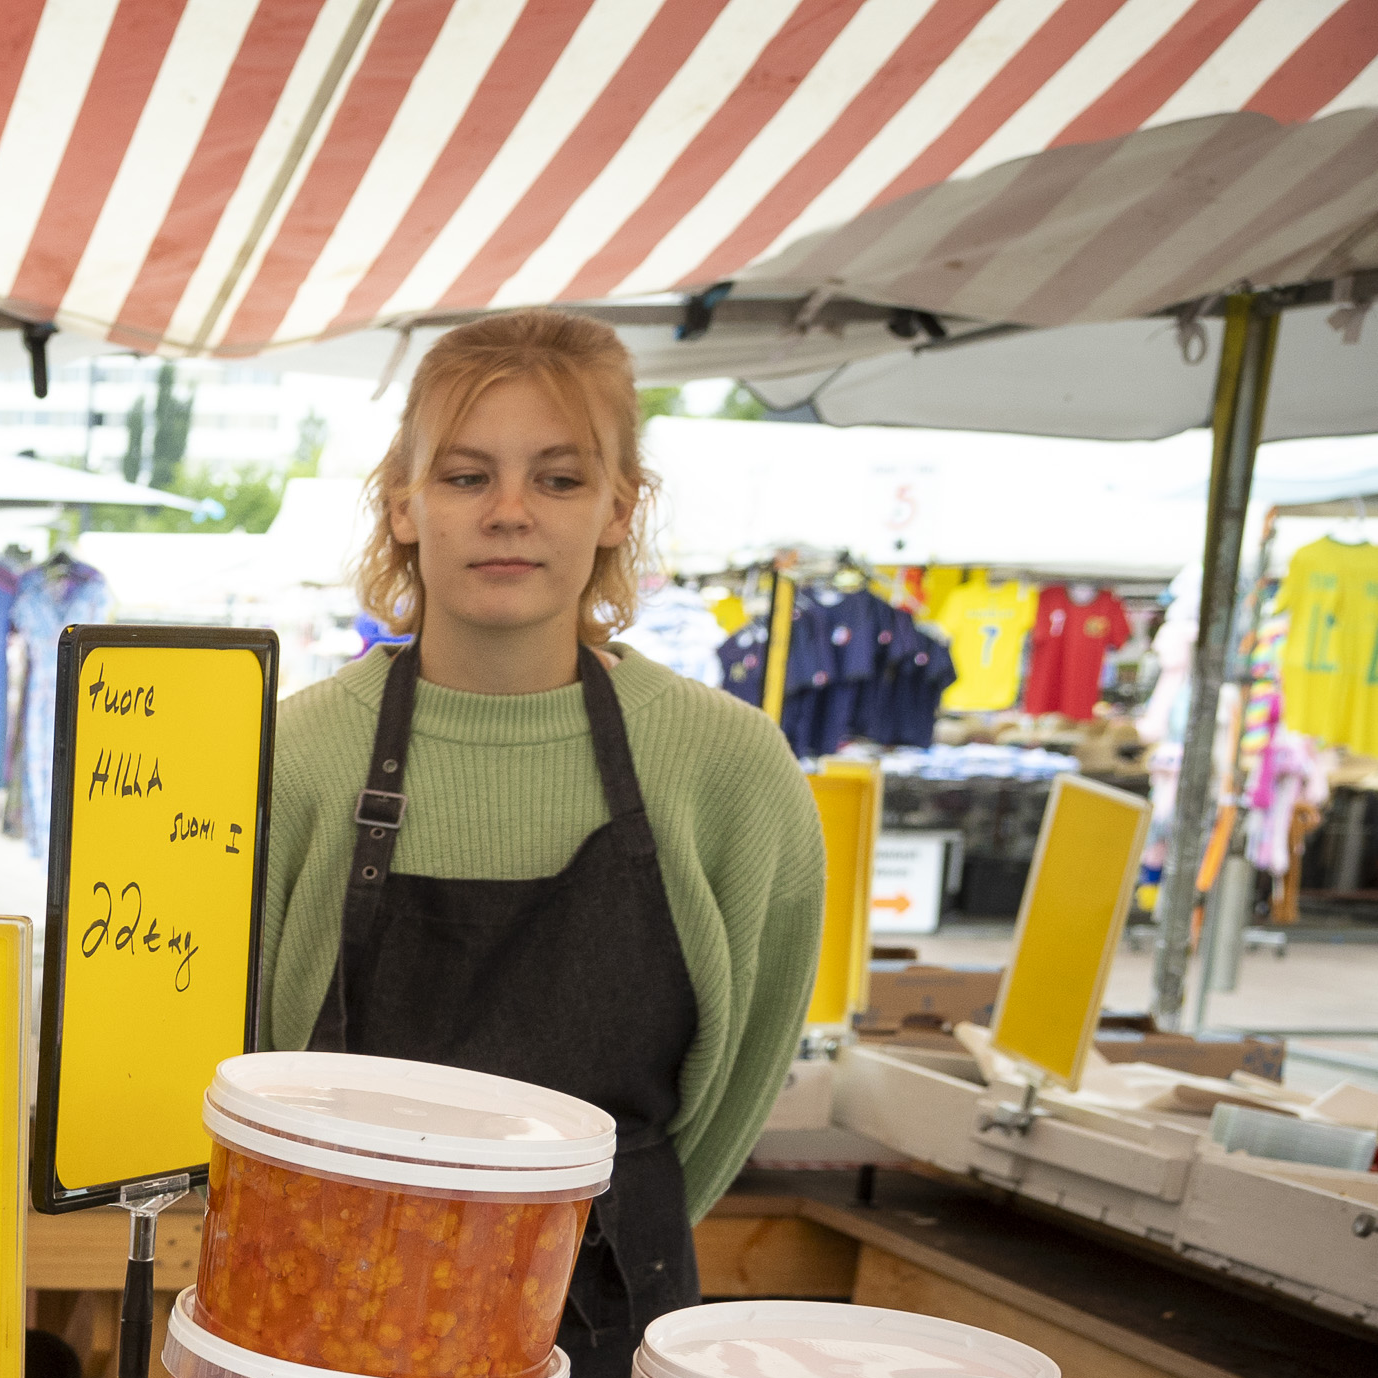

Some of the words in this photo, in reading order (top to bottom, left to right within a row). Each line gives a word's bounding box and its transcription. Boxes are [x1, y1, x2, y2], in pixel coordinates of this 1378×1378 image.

[89, 663, 156, 717] tuore
[89, 748, 163, 801] HILLA
[170, 812, 216, 843] SUOMI
